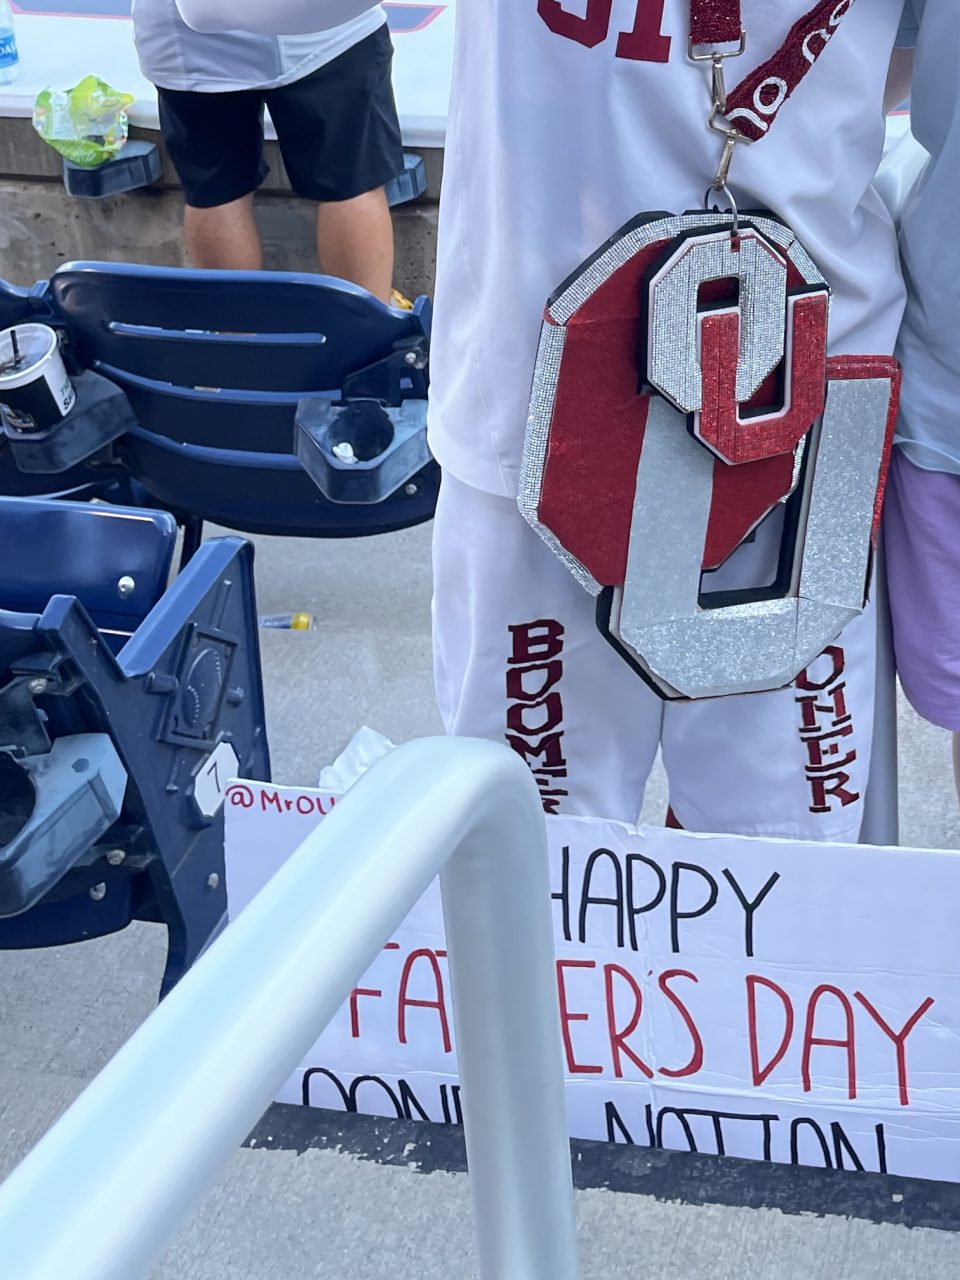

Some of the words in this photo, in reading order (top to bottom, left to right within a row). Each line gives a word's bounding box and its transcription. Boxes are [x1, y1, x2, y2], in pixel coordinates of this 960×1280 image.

[505, 619, 569, 816] BOOM
[350, 942, 704, 1078] FAER'S
[745, 974, 935, 1106] DAY
